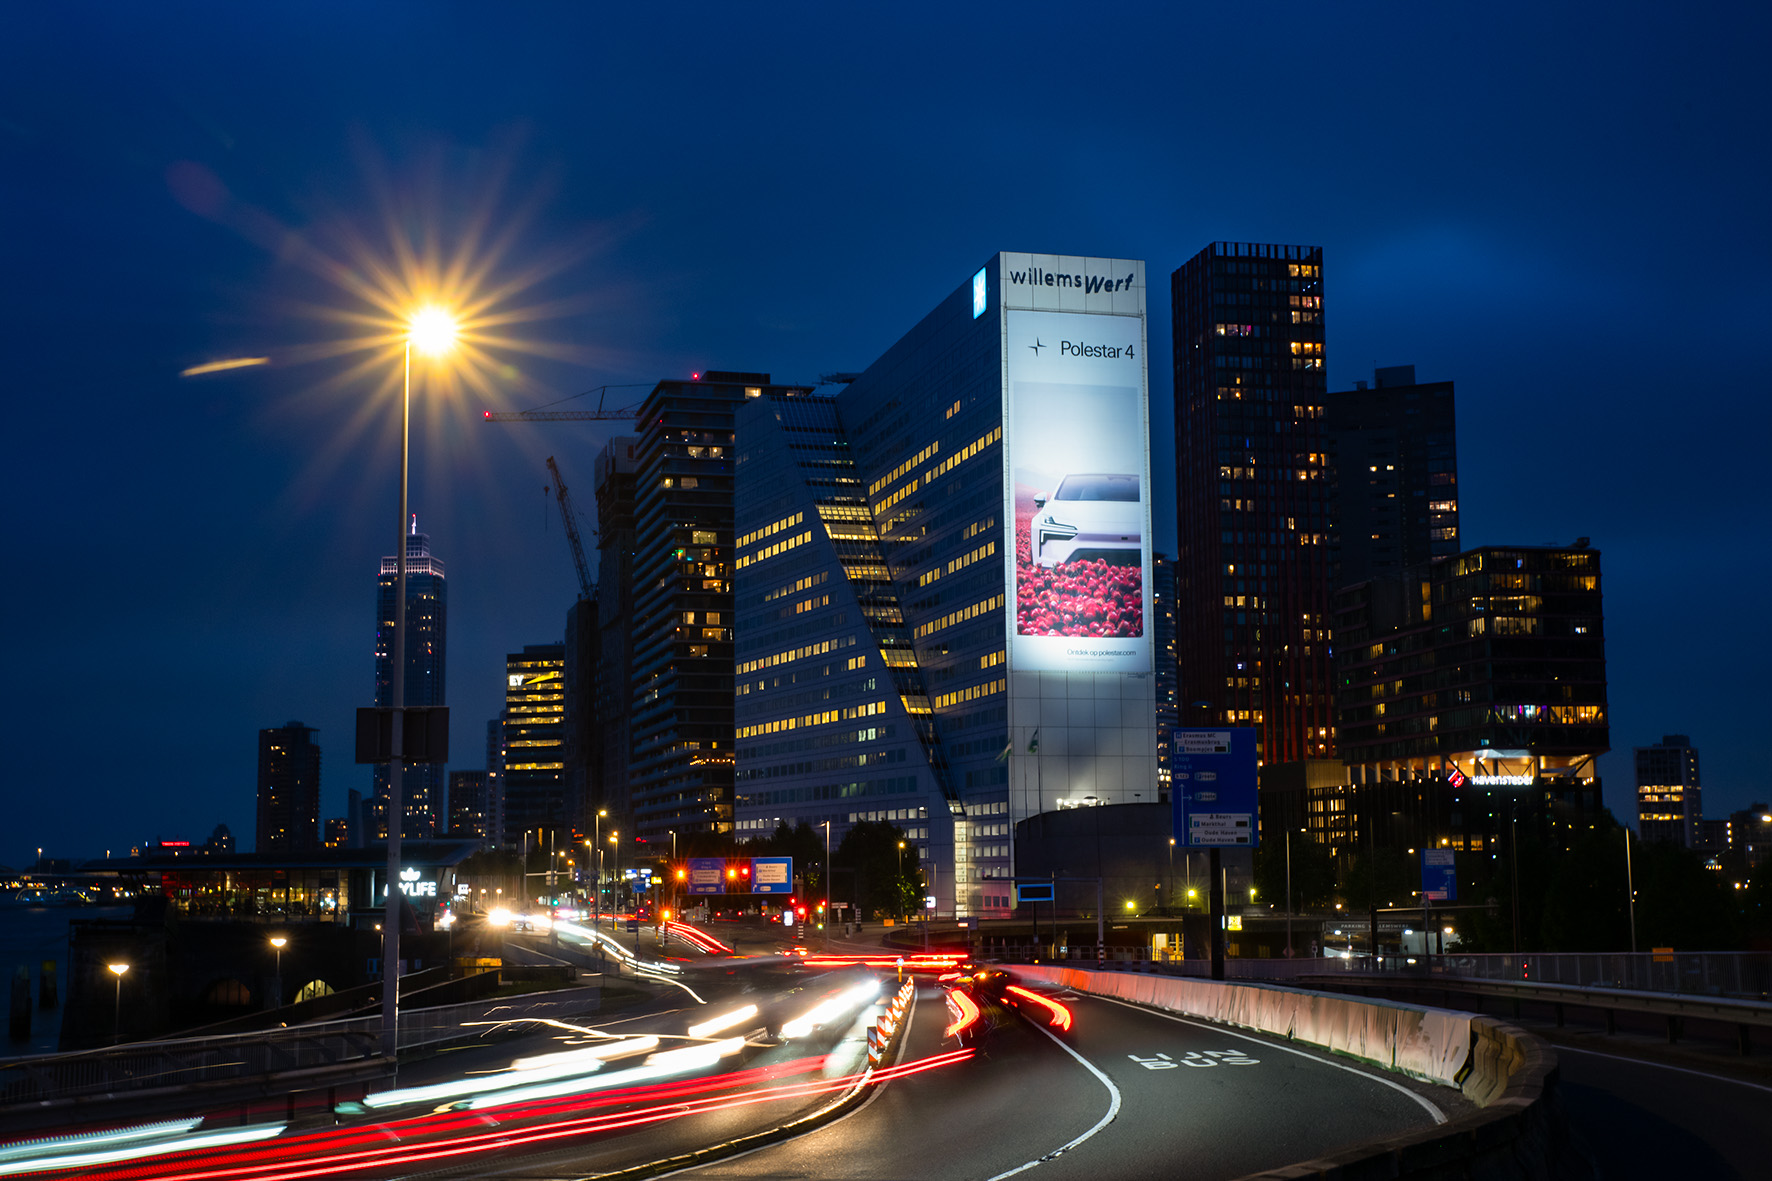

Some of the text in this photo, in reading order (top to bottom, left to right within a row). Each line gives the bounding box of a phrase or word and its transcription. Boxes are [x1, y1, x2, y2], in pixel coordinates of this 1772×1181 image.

[1060, 340, 1135, 360] Polestar 4
[509, 675, 524, 686] EY
[1140, 1056, 1261, 1070] BUS
